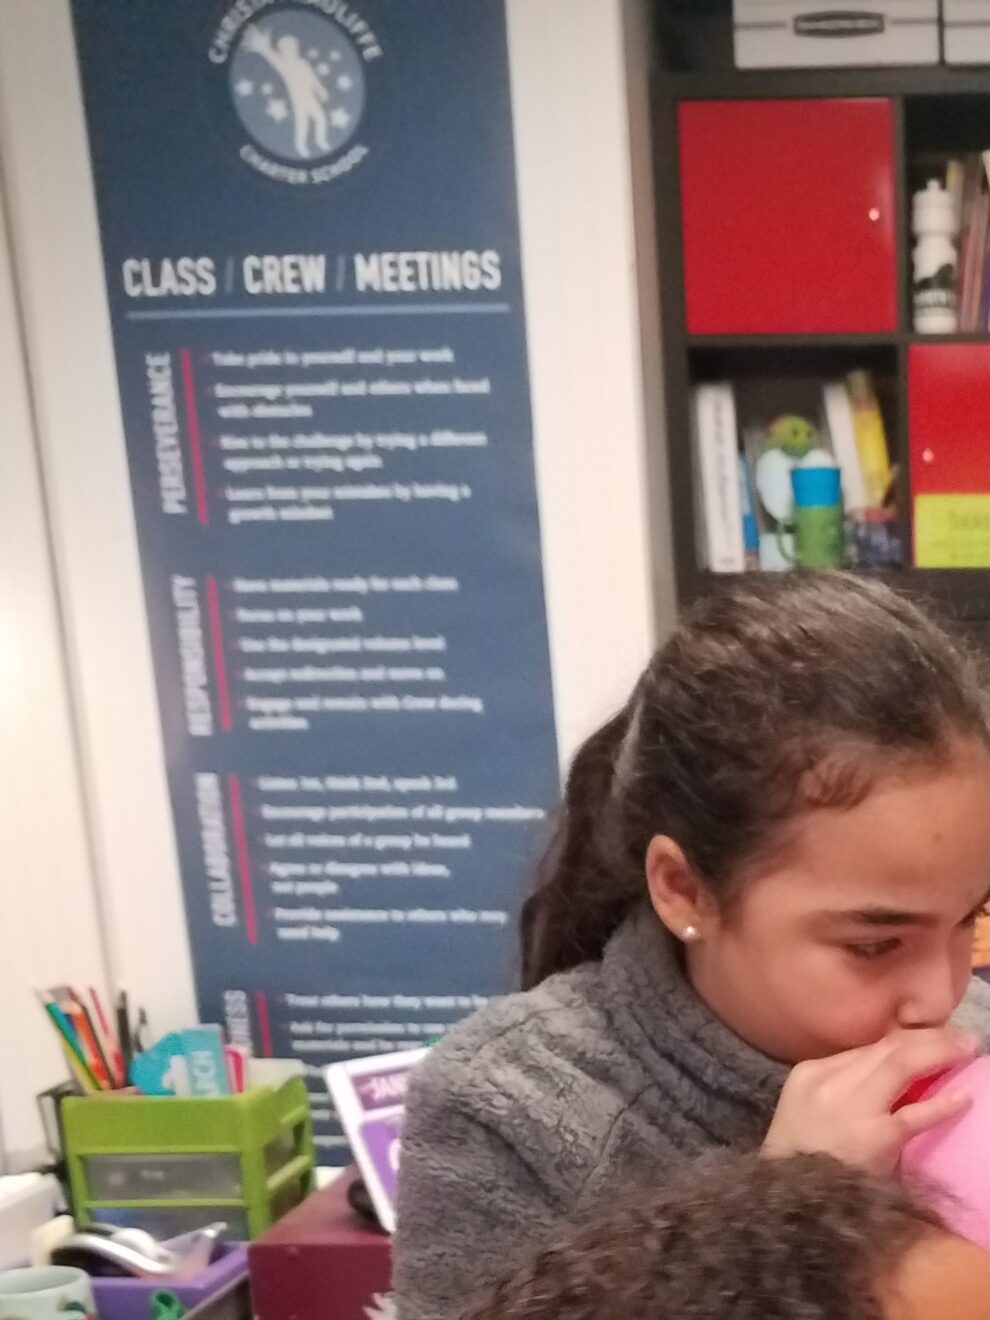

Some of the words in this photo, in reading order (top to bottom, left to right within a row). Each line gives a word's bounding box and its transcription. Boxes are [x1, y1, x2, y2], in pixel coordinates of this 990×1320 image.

[122, 257, 216, 297] CLASS
[243, 254, 326, 293] CREW
[354, 250, 502, 292] MEETINGS
[146, 352, 188, 514] PERSEVERANCE
[172, 574, 214, 736] RESPONSIBILITY
[195, 772, 237, 927] COLLABORATION
